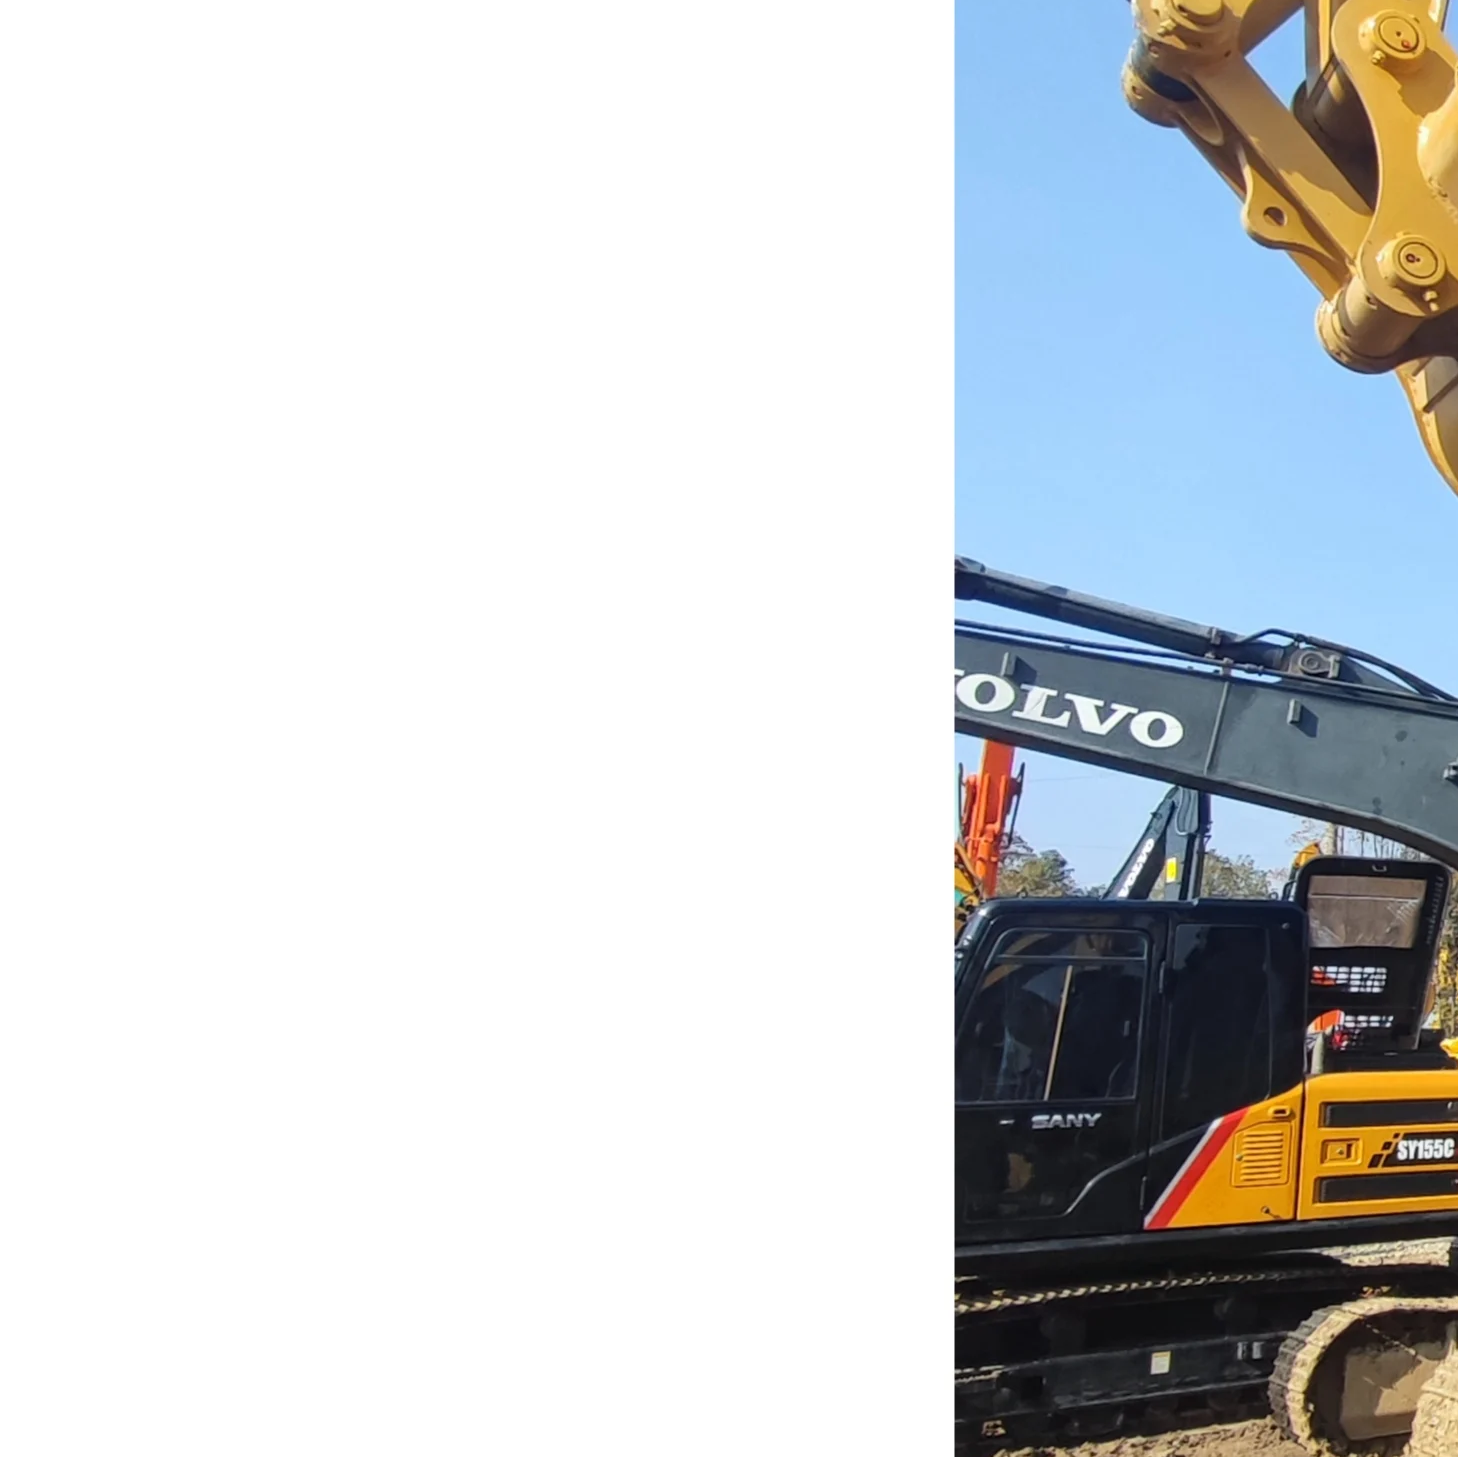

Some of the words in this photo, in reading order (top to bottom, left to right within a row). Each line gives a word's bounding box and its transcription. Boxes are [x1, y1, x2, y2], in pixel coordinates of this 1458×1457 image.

[955, 669, 1184, 748] OLVO
[1031, 1113, 1102, 1130] SANY
[1397, 1138, 1455, 1161] SY155C
